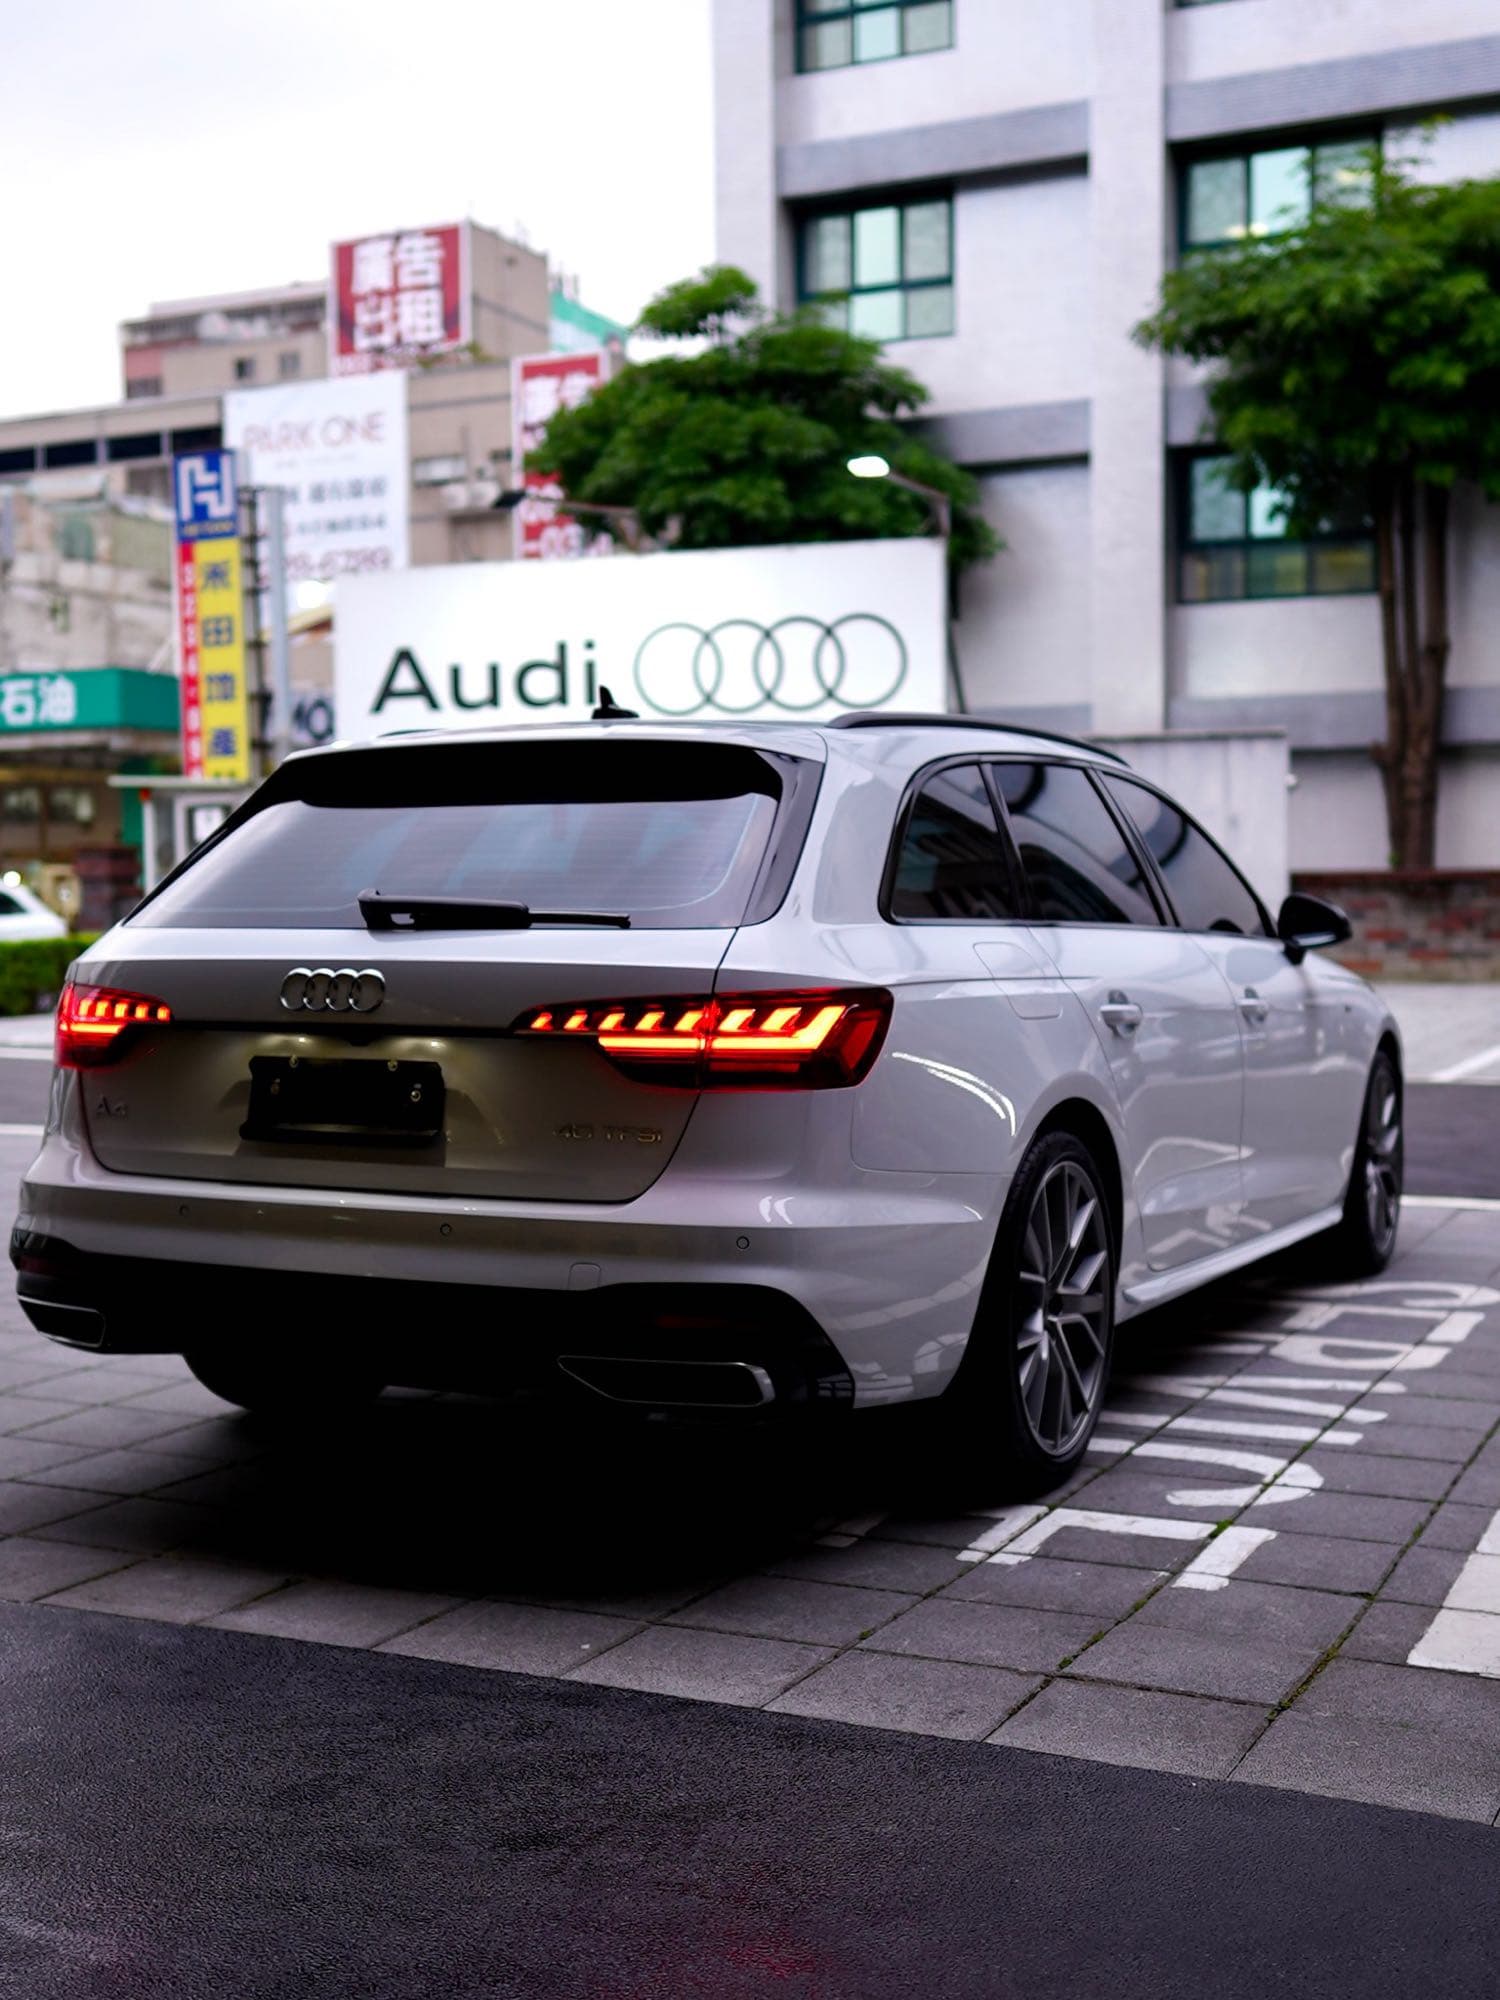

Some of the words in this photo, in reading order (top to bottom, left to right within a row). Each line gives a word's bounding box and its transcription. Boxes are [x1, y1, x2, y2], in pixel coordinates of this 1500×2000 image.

[242, 420, 316, 451] PARK
[320, 409, 388, 447] ONE
[0, 674, 77, 726] 石油
[368, 639, 597, 716] Audi
[93, 1094, 128, 1120] A4
